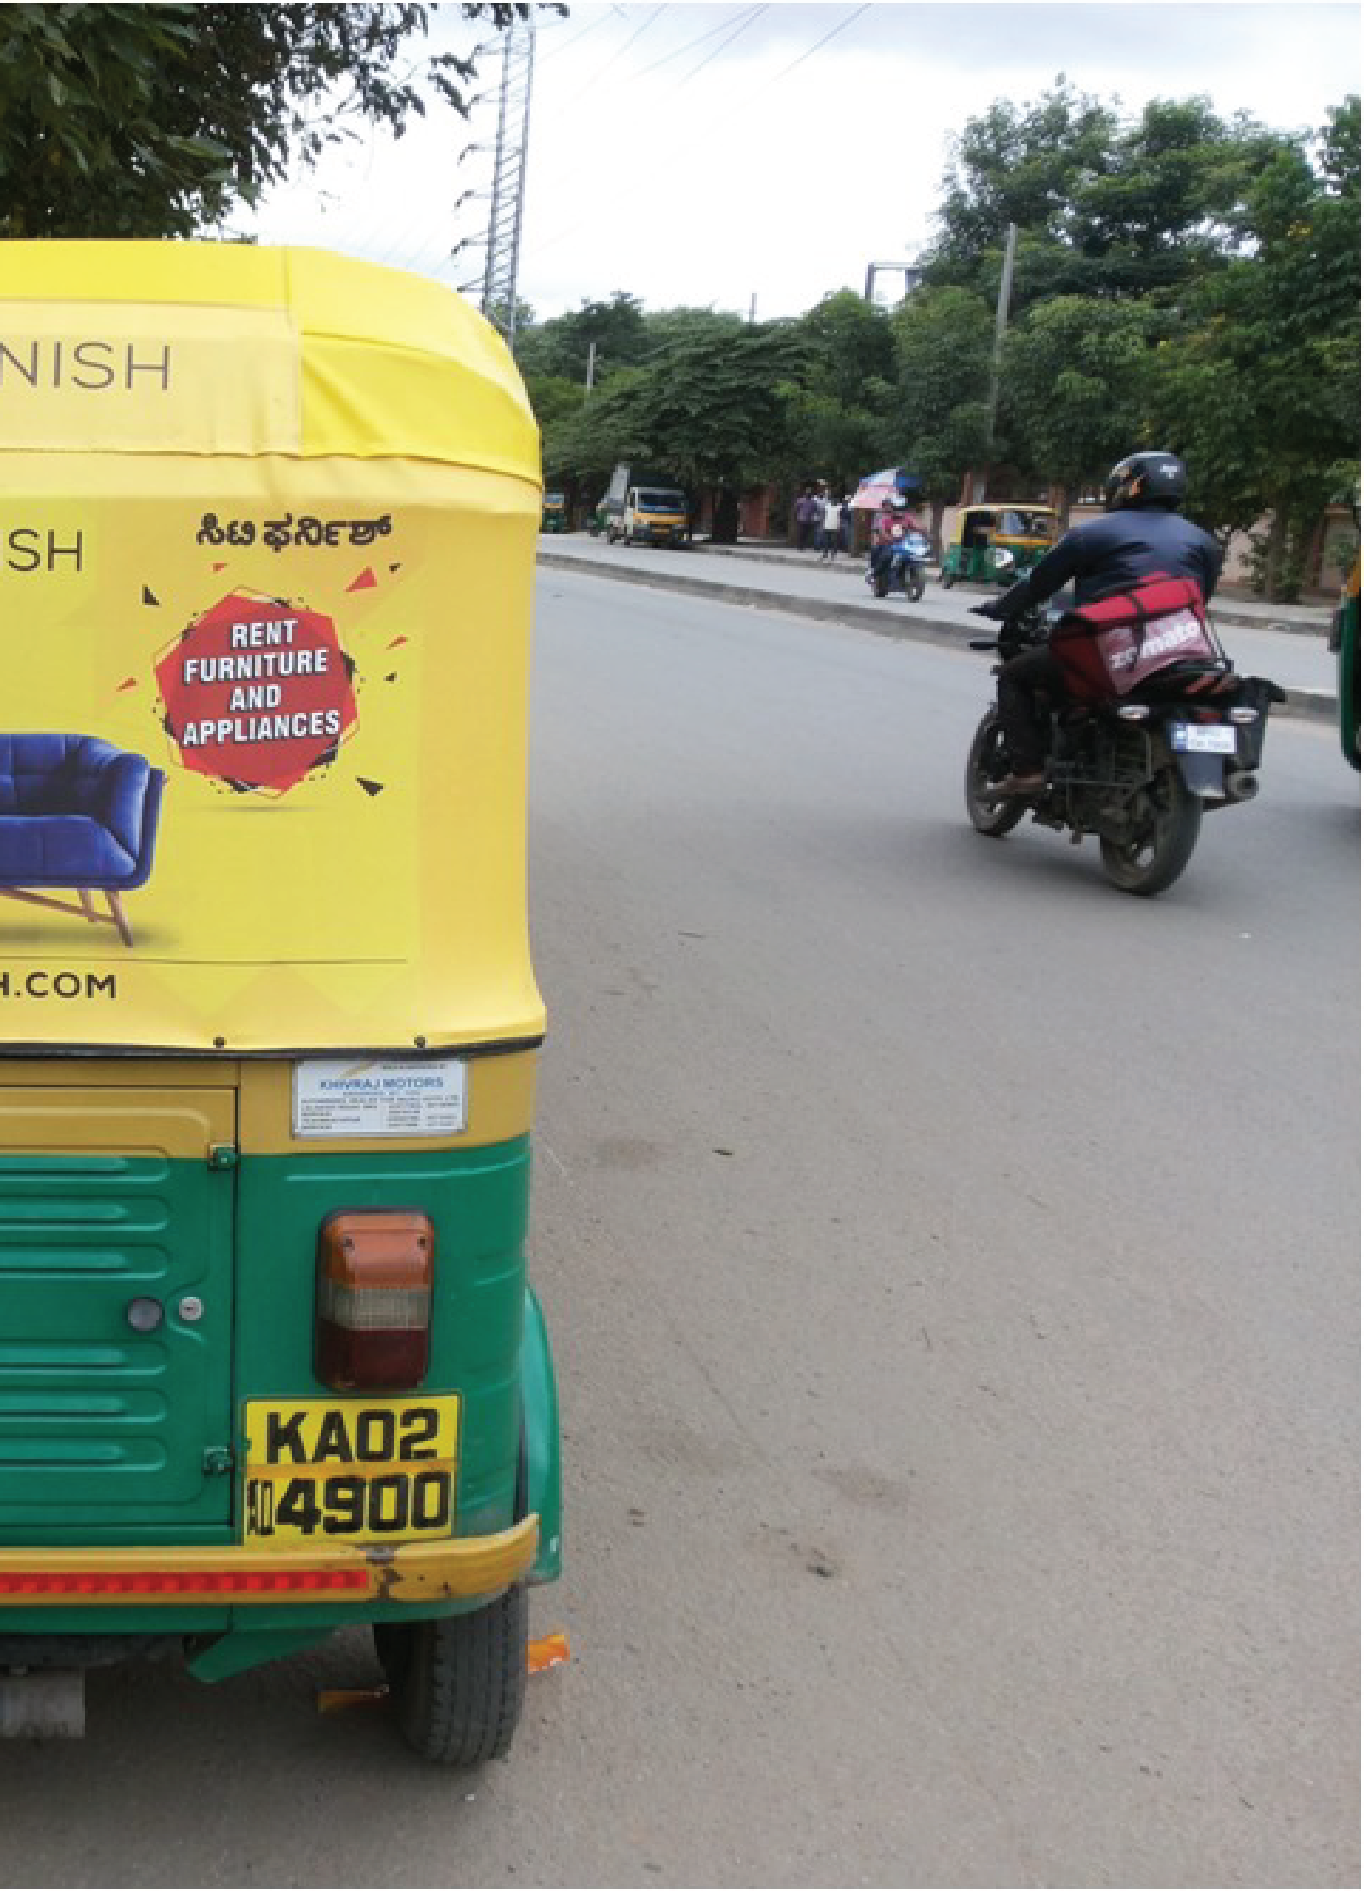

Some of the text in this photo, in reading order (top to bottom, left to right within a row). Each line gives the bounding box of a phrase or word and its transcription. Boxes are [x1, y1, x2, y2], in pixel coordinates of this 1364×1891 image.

[196, 512, 256, 546] ಸಿಟಿ
[231, 618, 298, 649] RENT
[183, 649, 330, 684] FURNITURE
[229, 684, 283, 712] AND
[182, 709, 340, 747] APPLIANCES
[382, 1076, 444, 1089] MOTORS
[266, 1407, 441, 1465] KA02
[275, 1471, 452, 1536] 4900
